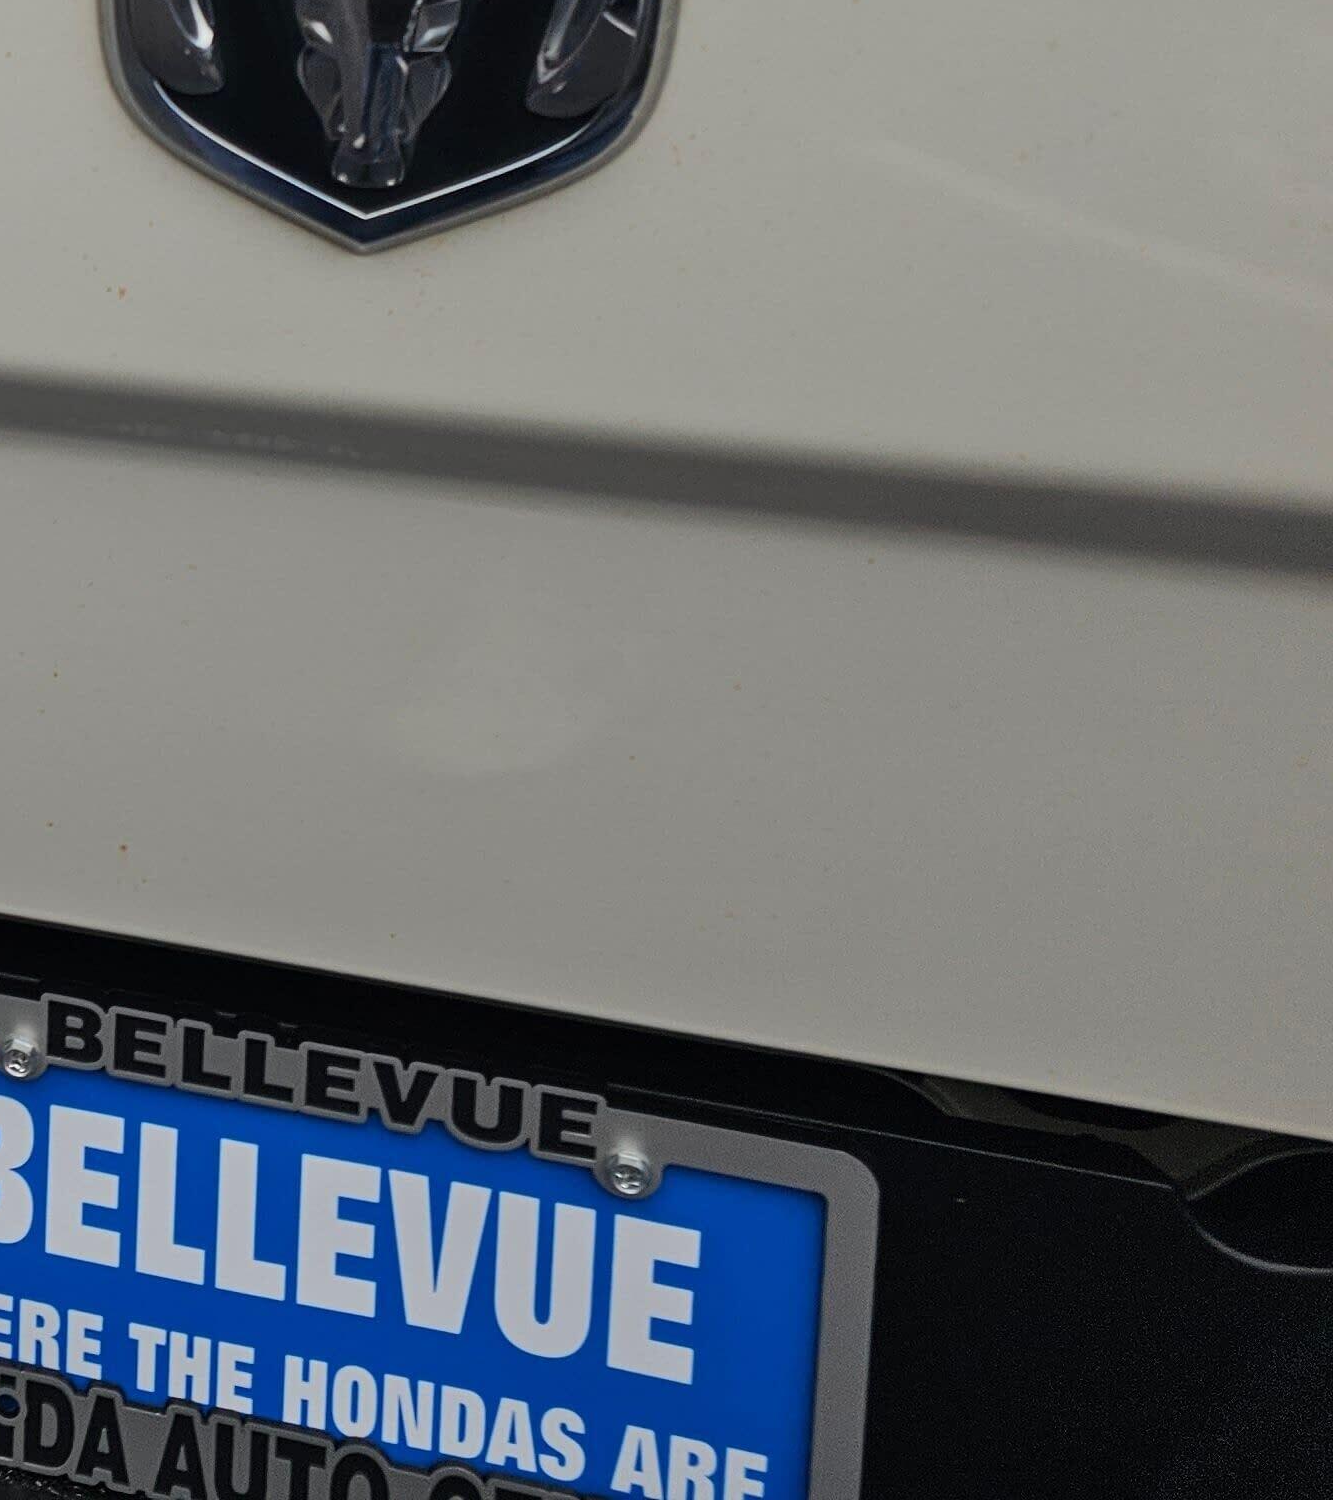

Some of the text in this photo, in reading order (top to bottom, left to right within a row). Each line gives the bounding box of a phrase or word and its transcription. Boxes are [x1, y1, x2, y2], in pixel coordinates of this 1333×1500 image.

[46, 1000, 600, 1160] BELLEVUE
[128, 1322, 256, 1415] THE
[283, 1354, 586, 1482] HONDAS
[610, 1424, 769, 1500] ARE
[152, 1412, 389, 1500] AUTO
